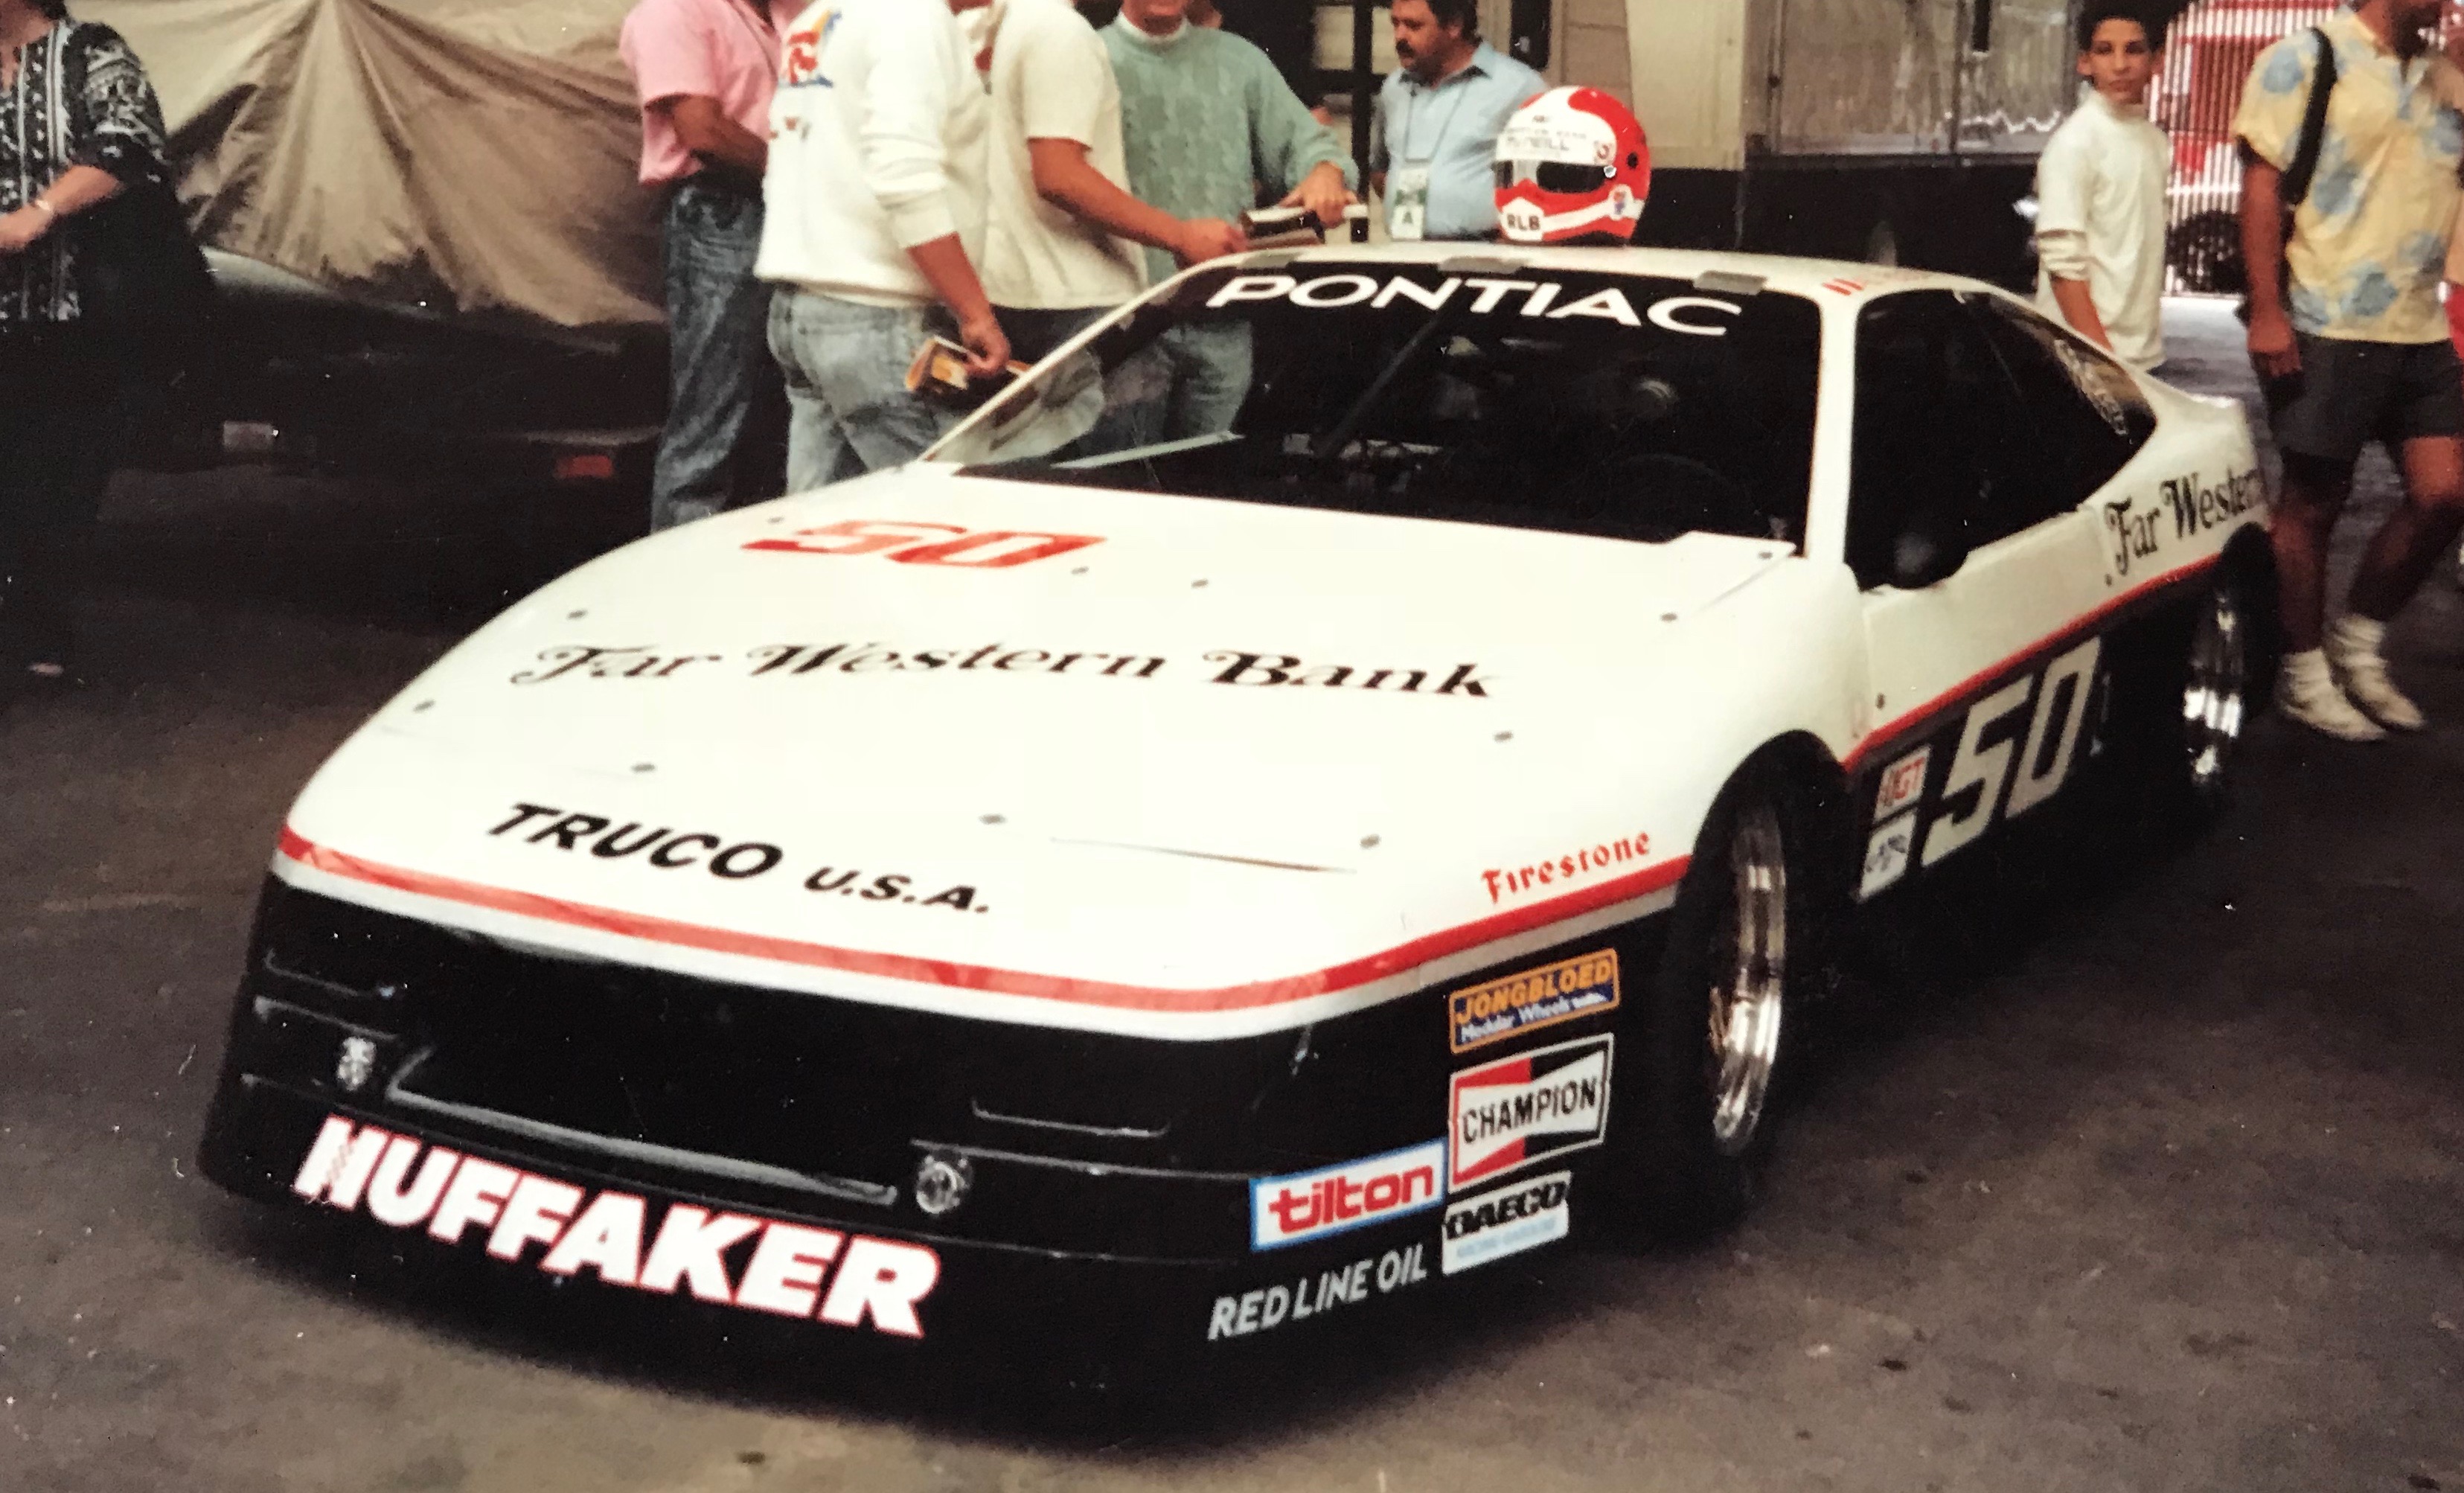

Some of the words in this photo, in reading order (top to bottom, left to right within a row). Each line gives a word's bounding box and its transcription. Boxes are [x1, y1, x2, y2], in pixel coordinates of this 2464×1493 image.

[1507, 213, 1541, 232] RLB
[1205, 273, 1743, 337] PONTIAC
[739, 519, 1107, 569] 50
[2105, 496, 2160, 576] Far
[510, 643, 723, 685] Far
[746, 641, 1168, 678] Western
[1201, 649, 1497, 697] Bank
[1920, 636, 2102, 868] 50
[486, 801, 784, 880] TRUCO
[803, 866, 990, 915] U.S.A.
[1480, 831, 1650, 904] Firestone
[1454, 958, 1613, 1024] JONGBLOED
[1462, 1075, 1598, 1144] CHAMPION
[294, 1112, 941, 1340] HUFFAKER
[1267, 1164, 1434, 1235] tilton
[1206, 1284, 1290, 1341] RED
[1291, 1258, 1374, 1320] LINE
[1376, 1241, 1428, 1293] OIL
